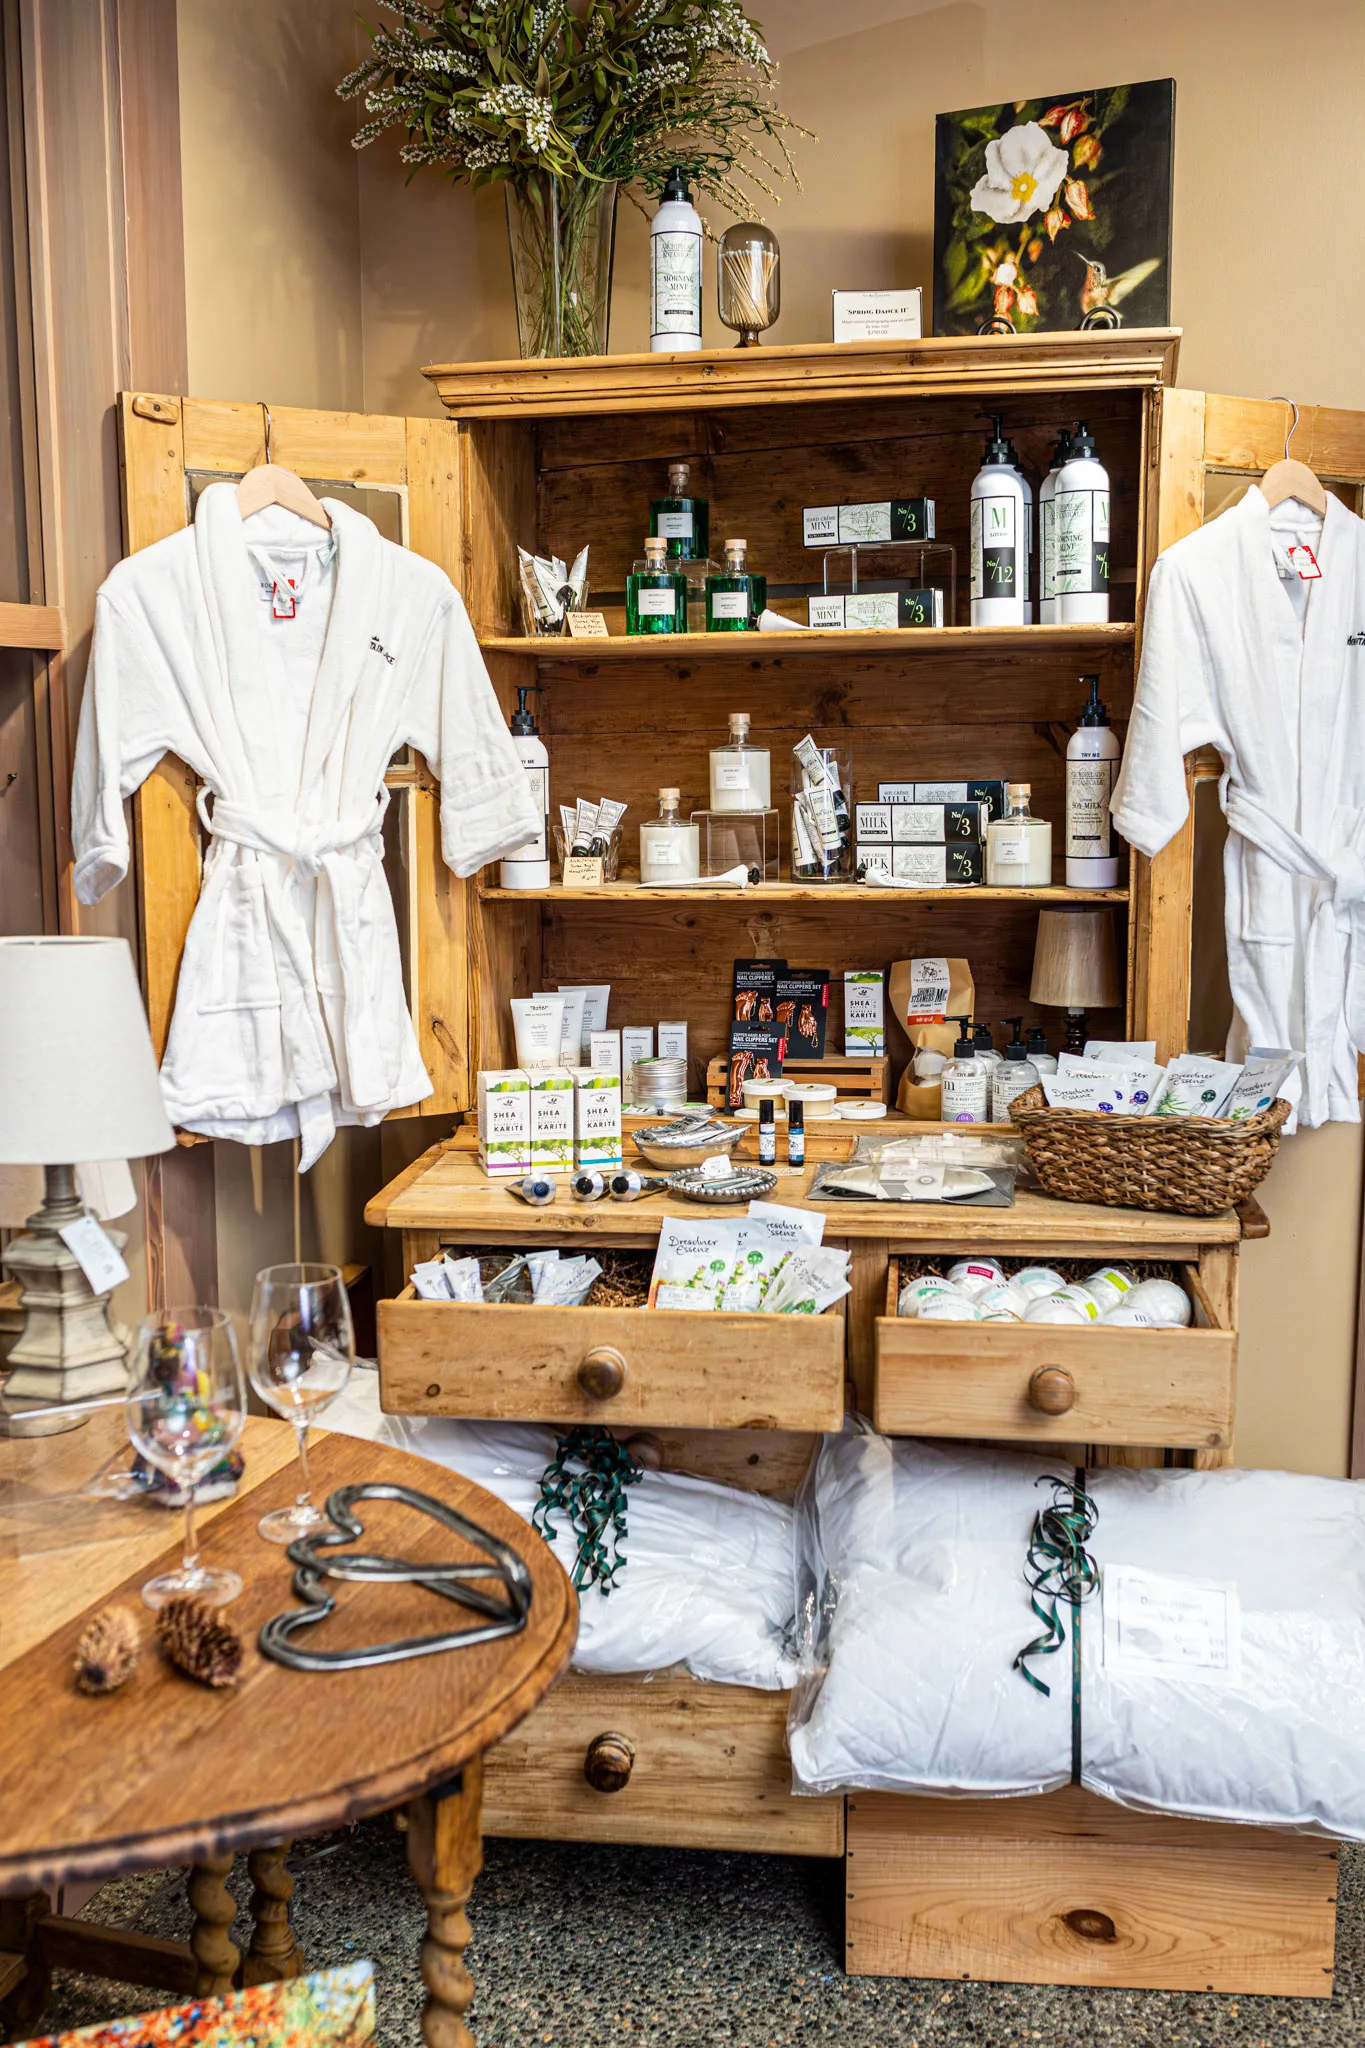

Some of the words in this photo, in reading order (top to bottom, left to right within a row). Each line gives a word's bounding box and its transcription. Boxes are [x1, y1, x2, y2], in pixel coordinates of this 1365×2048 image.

[670, 283, 688, 291] MINT
[990, 507, 1006, 529] M
[810, 521, 832, 531] MINT
[816, 610, 838, 620] MINT
[860, 817, 888, 828] MILK
[1168, 1072, 1215, 1081] Dresdner
[1051, 1088, 1094, 1098] Dresdner
[766, 1220, 804, 1231] resdner
[769, 1229, 797, 1238] ssenz
[668, 1235, 718, 1247] Dresdner
[676, 1245, 710, 1256] Essenz
